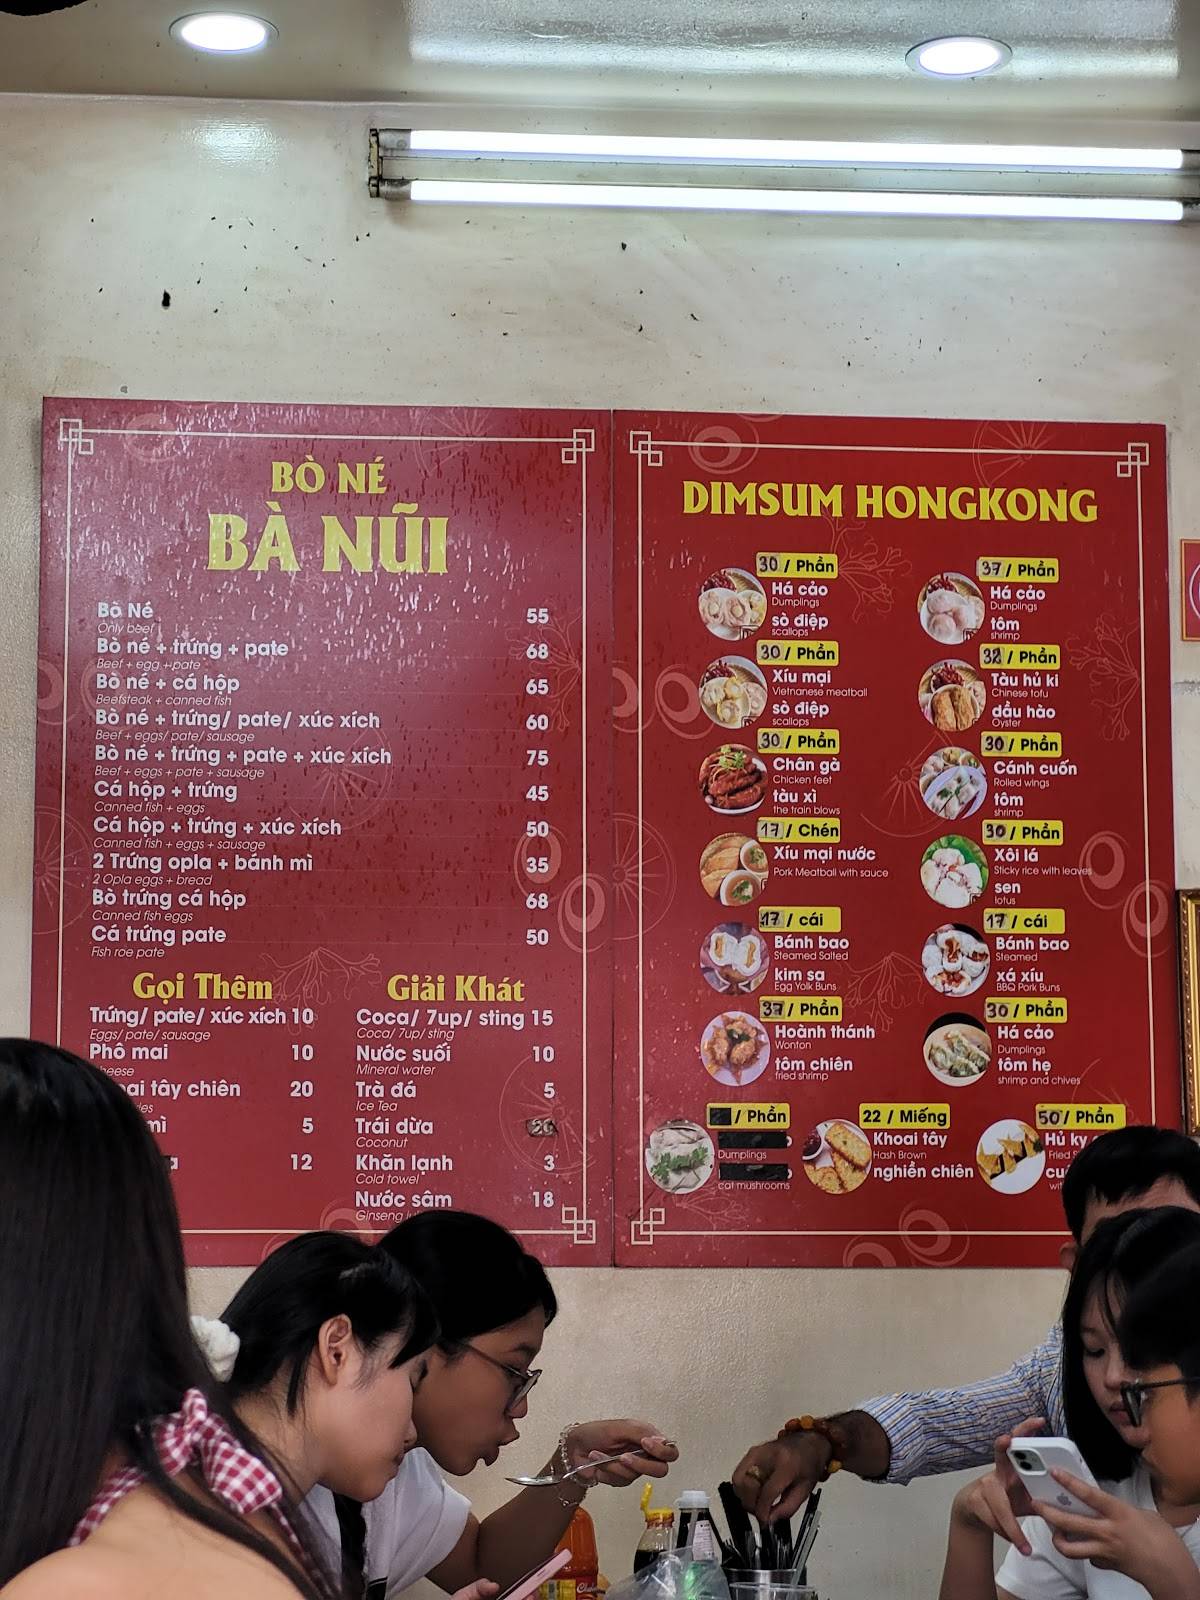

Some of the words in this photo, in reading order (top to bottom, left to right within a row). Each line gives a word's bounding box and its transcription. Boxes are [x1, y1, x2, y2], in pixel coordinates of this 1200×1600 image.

[271, 455, 326, 493] BÒ
[338, 456, 387, 494] NÉ
[682, 480, 843, 517] DIMSUM
[856, 485, 1098, 522] HONGKONG
[207, 501, 302, 572] BÀ
[321, 503, 450, 574] NŨI
[759, 556, 778, 572] 30
[796, 556, 834, 572] Phần
[772, 582, 793, 595] Há
[798, 582, 828, 595] cảo
[772, 598, 819, 607] Dumplings
[98, 602, 122, 618] Bò
[128, 602, 153, 618] Né
[527, 608, 549, 623] 55
[98, 623, 124, 636] Only
[127, 623, 154, 634] beef
[96, 674, 120, 689] Bò
[126, 673, 149, 689] né
[172, 674, 196, 690] cá
[204, 674, 240, 694] hộp
[526, 679, 549, 694] 65
[991, 672, 1018, 686] Tàu
[1023, 671, 1041, 687] hủ
[1046, 674, 1058, 687] ki
[96, 694, 152, 704] Beefsteak
[165, 696, 210, 705] canned
[214, 696, 232, 706] fish
[992, 689, 1028, 697] Chinese
[1030, 689, 1048, 698] tofu
[992, 701, 1021, 718] dầu
[1027, 704, 1055, 718] hào
[992, 719, 1020, 728] Oyster
[760, 733, 780, 747] 30
[798, 732, 836, 748] Phần
[773, 757, 814, 771] Chân
[819, 757, 840, 774] gà
[773, 776, 811, 784] Chicken
[813, 776, 832, 784] feet
[773, 789, 798, 803] tàu
[803, 790, 816, 803] xì
[773, 806, 789, 815] the
[791, 806, 811, 815] train
[814, 807, 840, 815] blows
[799, 823, 839, 836] Chén
[773, 846, 798, 860] Xíu
[804, 847, 833, 863] mại
[837, 846, 876, 860] nước
[994, 848, 1019, 862] Xôi
[1024, 848, 1038, 862] lá
[774, 868, 793, 877] Pork
[795, 868, 836, 877] Meatball
[839, 868, 858, 877] with
[994, 866, 1019, 876] Sticky
[1022, 866, 1039, 875] rice
[1041, 867, 1060, 876] with
[1062, 867, 1092, 876] leaves
[995, 882, 1020, 894] sen
[92, 888, 116, 906] Bò
[122, 889, 172, 910] trứng
[178, 890, 202, 906] cá
[210, 890, 246, 910] hộp
[526, 893, 549, 909] 68
[995, 896, 1016, 905] lotus
[92, 910, 141, 921] Canned
[143, 910, 162, 922] fish
[164, 912, 193, 923] eggs
[92, 926, 119, 942] Cá
[126, 926, 176, 946] trứng
[182, 927, 226, 945] pate
[526, 929, 549, 945] 50
[775, 934, 813, 949] Bánh
[819, 936, 849, 949] bao
[92, 947, 112, 958] Fish
[114, 948, 133, 958] roe
[136, 947, 164, 959] pate
[774, 951, 817, 960] Steamed
[819, 952, 849, 961] Salted
[775, 968, 803, 981] kim
[807, 971, 825, 981] sa
[133, 972, 184, 1004] Gọi
[193, 973, 273, 999] Thêm
[387, 974, 444, 1001] Giải
[455, 975, 525, 1002] Khát
[775, 983, 792, 992] Egg
[795, 982, 814, 991] Yolk
[815, 982, 836, 991] Buns
[154, 1008, 204, 1026] pate/
[210, 1006, 244, 1023] xúc
[248, 1007, 286, 1024] xích
[292, 1008, 313, 1024] 10
[357, 1009, 419, 1026] Coca/
[427, 1009, 472, 1028] 7up/
[479, 1010, 524, 1030] sting
[532, 1010, 553, 1026] 15
[161, 1031, 210, 1042] sausage
[775, 1025, 826, 1038] Hoành
[831, 1025, 875, 1039] thánh
[90, 1043, 125, 1060] Phô
[132, 1044, 168, 1060] mai
[292, 1045, 313, 1060] 10
[356, 1044, 406, 1061] Nước
[412, 1042, 451, 1062] suối
[532, 1047, 554, 1062] 10
[775, 1041, 811, 1050] Wonton
[356, 1064, 399, 1075] Mineral
[402, 1066, 435, 1076] water
[775, 1057, 805, 1070] tôm
[810, 1057, 853, 1071] chiên
[99, 1066, 134, 1077] heese
[775, 1072, 796, 1080] fried
[798, 1072, 828, 1082] shrimp
[151, 1080, 181, 1099] tây
[187, 1080, 240, 1097] chiên
[290, 1081, 313, 1096] 20
[355, 1081, 384, 1097] Trà
[391, 1081, 417, 1098] đá
[544, 1083, 555, 1098] 5
[356, 1101, 374, 1111] Ice
[378, 1101, 397, 1112] Tea
[863, 1110, 881, 1122] 22
[900, 1107, 947, 1126] Miếng
[1076, 1108, 1114, 1123] Phần
[302, 1118, 313, 1133] 5
[355, 1117, 390, 1134] Trái
[396, 1118, 433, 1134] dừa
[356, 1138, 407, 1148] Coconut
[873, 1132, 917, 1146] Khoai
[923, 1132, 947, 1149] tây
[1045, 1132, 1065, 1146] Hủ
[718, 1151, 767, 1160] Dumplings
[873, 1151, 895, 1159] Hash
[898, 1150, 927, 1159] Brown
[1048, 1151, 1070, 1159] Fried
[291, 1154, 312, 1170] 12
[356, 1155, 405, 1171] Khăn
[412, 1155, 453, 1175] lạnh
[544, 1156, 555, 1171] 3
[873, 1160, 926, 1181] nghiền
[931, 1162, 974, 1179] chiên
[355, 1174, 384, 1185] Cold
[387, 1174, 419, 1185] towel
[737, 1182, 790, 1190] mushrooms
[355, 1189, 405, 1207] Nước
[412, 1191, 452, 1207] sâm
[532, 1192, 554, 1207] 18
